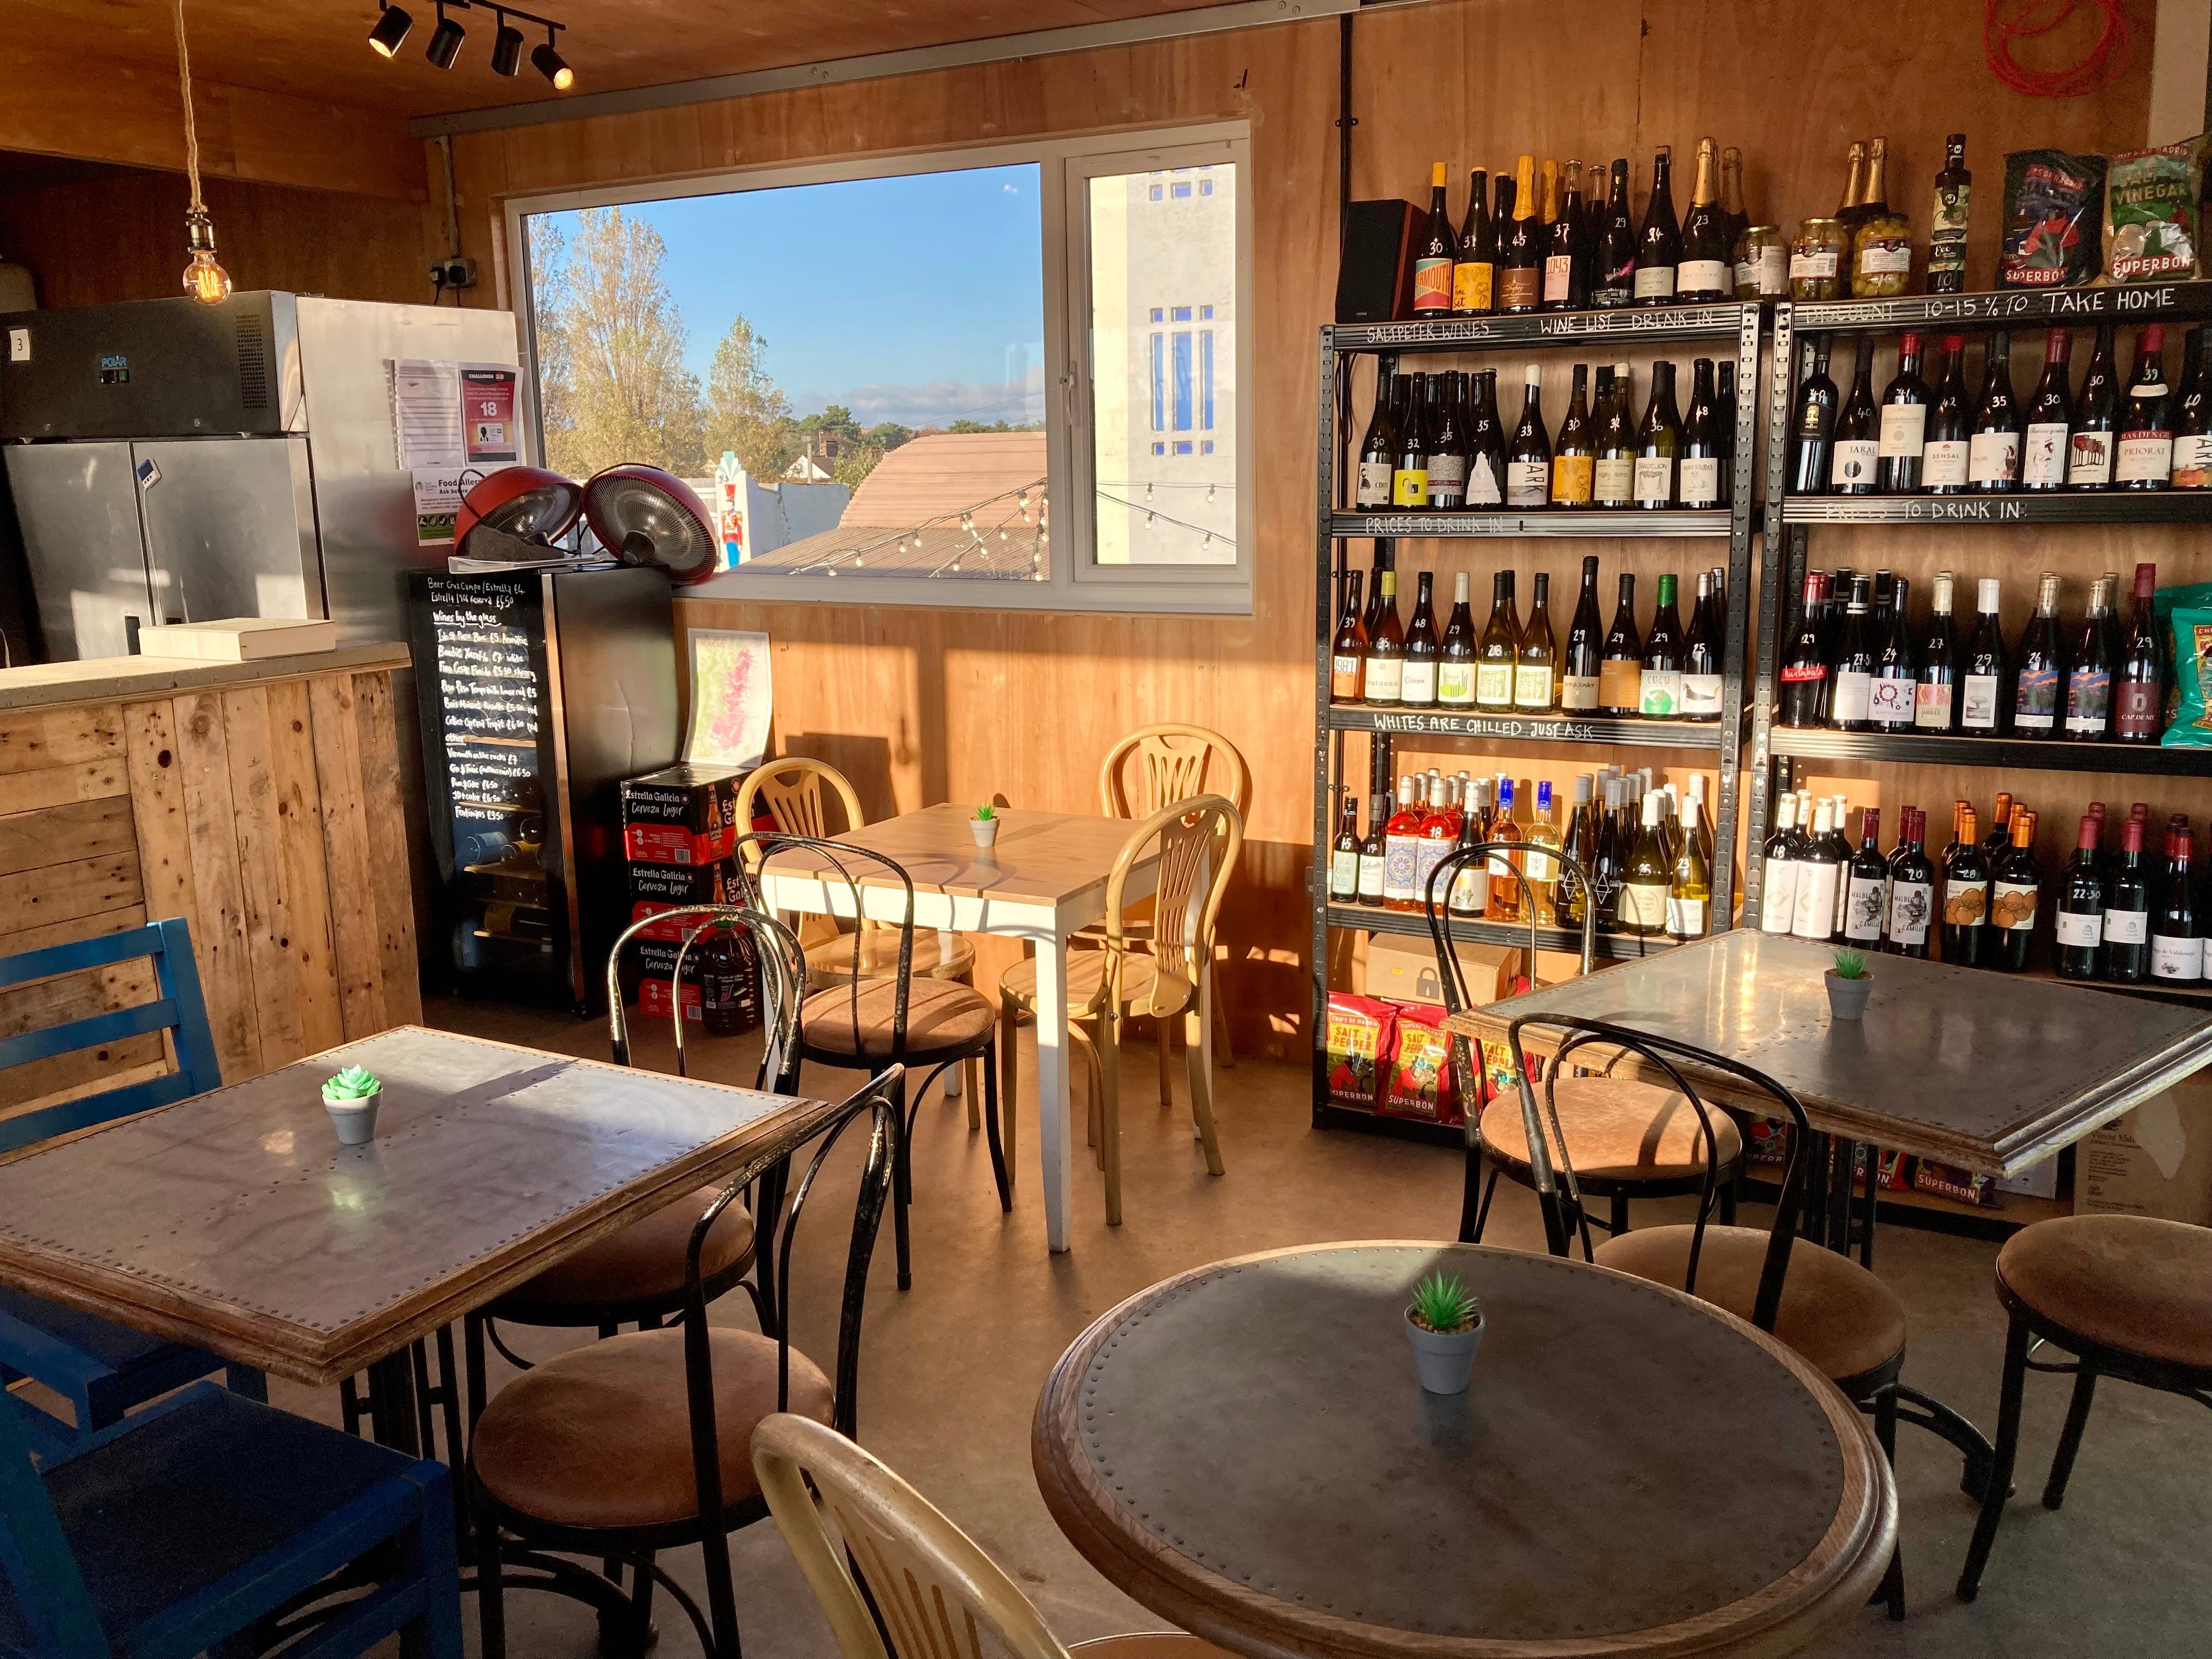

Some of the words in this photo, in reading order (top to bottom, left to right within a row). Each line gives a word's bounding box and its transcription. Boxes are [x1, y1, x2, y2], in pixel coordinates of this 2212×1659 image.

[2119, 167, 2159, 187] SALT
[2115, 183, 2187, 205] VINEGAR
[1615, 218, 1627, 228] 29
[1696, 215, 1709, 227] 23
[1554, 223, 1570, 243] 37
[1513, 235, 1527, 246] 45
[1429, 241, 1443, 256] 30
[1547, 258, 1568, 274] 1043
[1937, 274, 1953, 288] 10
[1806, 302, 1900, 324] DISCOUNT
[2006, 295, 2028, 317] TO
[2042, 292, 2105, 314] TAKE
[2118, 288, 2175, 310] HOME
[1540, 316, 1577, 334] WINE
[1586, 313, 1615, 331] LIST
[1632, 311, 1687, 329] DRINK
[1696, 309, 1712, 325] IN
[1367, 323, 1436, 343] SALTPETER
[1442, 320, 1489, 338] WINES
[18, 338, 23, 352] 3
[101, 357, 127, 367] POLAR
[2142, 369, 2158, 381] 39
[1992, 396, 2007, 407] 35
[2044, 394, 2061, 406] 30
[480, 401, 497, 416] 18
[1858, 407, 1871, 419] 40
[1477, 420, 1489, 432] 35
[1651, 420, 1664, 431] 36
[1372, 437, 1385, 449] 30
[1408, 438, 1420, 449] 32
[1441, 432, 1453, 443] 35
[1849, 445, 1876, 454] JARAL
[2124, 447, 2165, 456] PRIORAT
[1525, 465, 1545, 493] ARK
[1902, 501, 1922, 518] TO
[1932, 501, 1991, 520] DRINK
[2000, 501, 2020, 519] IN
[1365, 517, 1412, 534] PRICES
[1418, 517, 1433, 532] TO
[1437, 517, 1481, 533] DRINK
[1489, 516, 1503, 533] IN
[427, 577, 444, 589] Beer
[514, 584, 526, 595] £4
[431, 592, 454, 603] Estrella
[470, 596, 492, 605] Reserva
[433, 610, 454, 622] Wines
[455, 610, 465, 628] by
[465, 611, 477, 621] the
[478, 612, 496, 629] glass
[1344, 617, 1356, 628] 39
[1414, 618, 1426, 628] 48
[1448, 625, 1460, 634] 29
[1573, 630, 1586, 641] 29
[489, 633, 499, 644] £5
[502, 632, 528, 646] Aromatic
[1611, 633, 1624, 643] 29
[1655, 633, 1668, 642] 29
[1802, 634, 1815, 644] 29
[1928, 638, 1944, 649] 27
[2136, 637, 2153, 648] 29
[1488, 644, 1503, 657] 28
[1692, 643, 1706, 654] 25
[1882, 648, 1897, 662] 24
[505, 652, 524, 663] white
[1975, 654, 1992, 667] 29
[2028, 652, 2041, 664] 26
[439, 661, 452, 673] Fino
[514, 667, 537, 683] sherry
[441, 679, 455, 693] Paso
[455, 680, 470, 694] Paso
[500, 685, 515, 696] house
[515, 685, 527, 697] red
[527, 686, 537, 698] £5
[443, 696, 459, 709] Bois
[527, 705, 538, 716] red
[486, 717, 505, 731] Trepat
[527, 722, 538, 732] red
[1374, 714, 1425, 731] WHITES
[1430, 716, 1460, 732] ARE
[1466, 719, 1522, 737] CHILLED
[1530, 722, 1561, 737] JUST
[1564, 723, 1594, 740] ASK
[445, 732, 466, 743] other
[447, 747, 473, 758] Vermouth
[478, 751, 489, 760] the
[490, 753, 506, 761] rocks
[507, 754, 518, 765] £7
[449, 763, 460, 774] Gin
[625, 789, 653, 800] Estrella
[654, 792, 680, 803] Galicia
[454, 804, 485, 819] Fentimans
[632, 802, 659, 814] Cerveza
[663, 803, 684, 817] Lager
[1431, 826, 1442, 839] 18
[1493, 833, 1505, 842] 22
[1341, 837, 1352, 850] 15
[1367, 844, 1378, 854] 17
[1773, 845, 1786, 859] 18
[1639, 863, 1652, 876] 25
[1677, 858, 1690, 869] 23
[633, 867, 660, 878] Estrella
[661, 870, 685, 881] Galicia
[1963, 869, 1976, 878] 28
[639, 880, 667, 891] Cerveza
[670, 881, 689, 895] Lager
[640, 946, 667, 958] Estrella
[646, 958, 673, 970] Cerveza
[1357, 1019, 1379, 1027] MADRID
[1335, 1026, 1359, 1039] SALT
[1407, 1033, 1425, 1043] SALT
[1334, 1037, 1371, 1051] PEPPER
[1484, 1043, 1506, 1057] SALT
[1388, 1094, 1434, 1110] SUPERBON
[1918, 1174, 1976, 1199] SUPERBON
